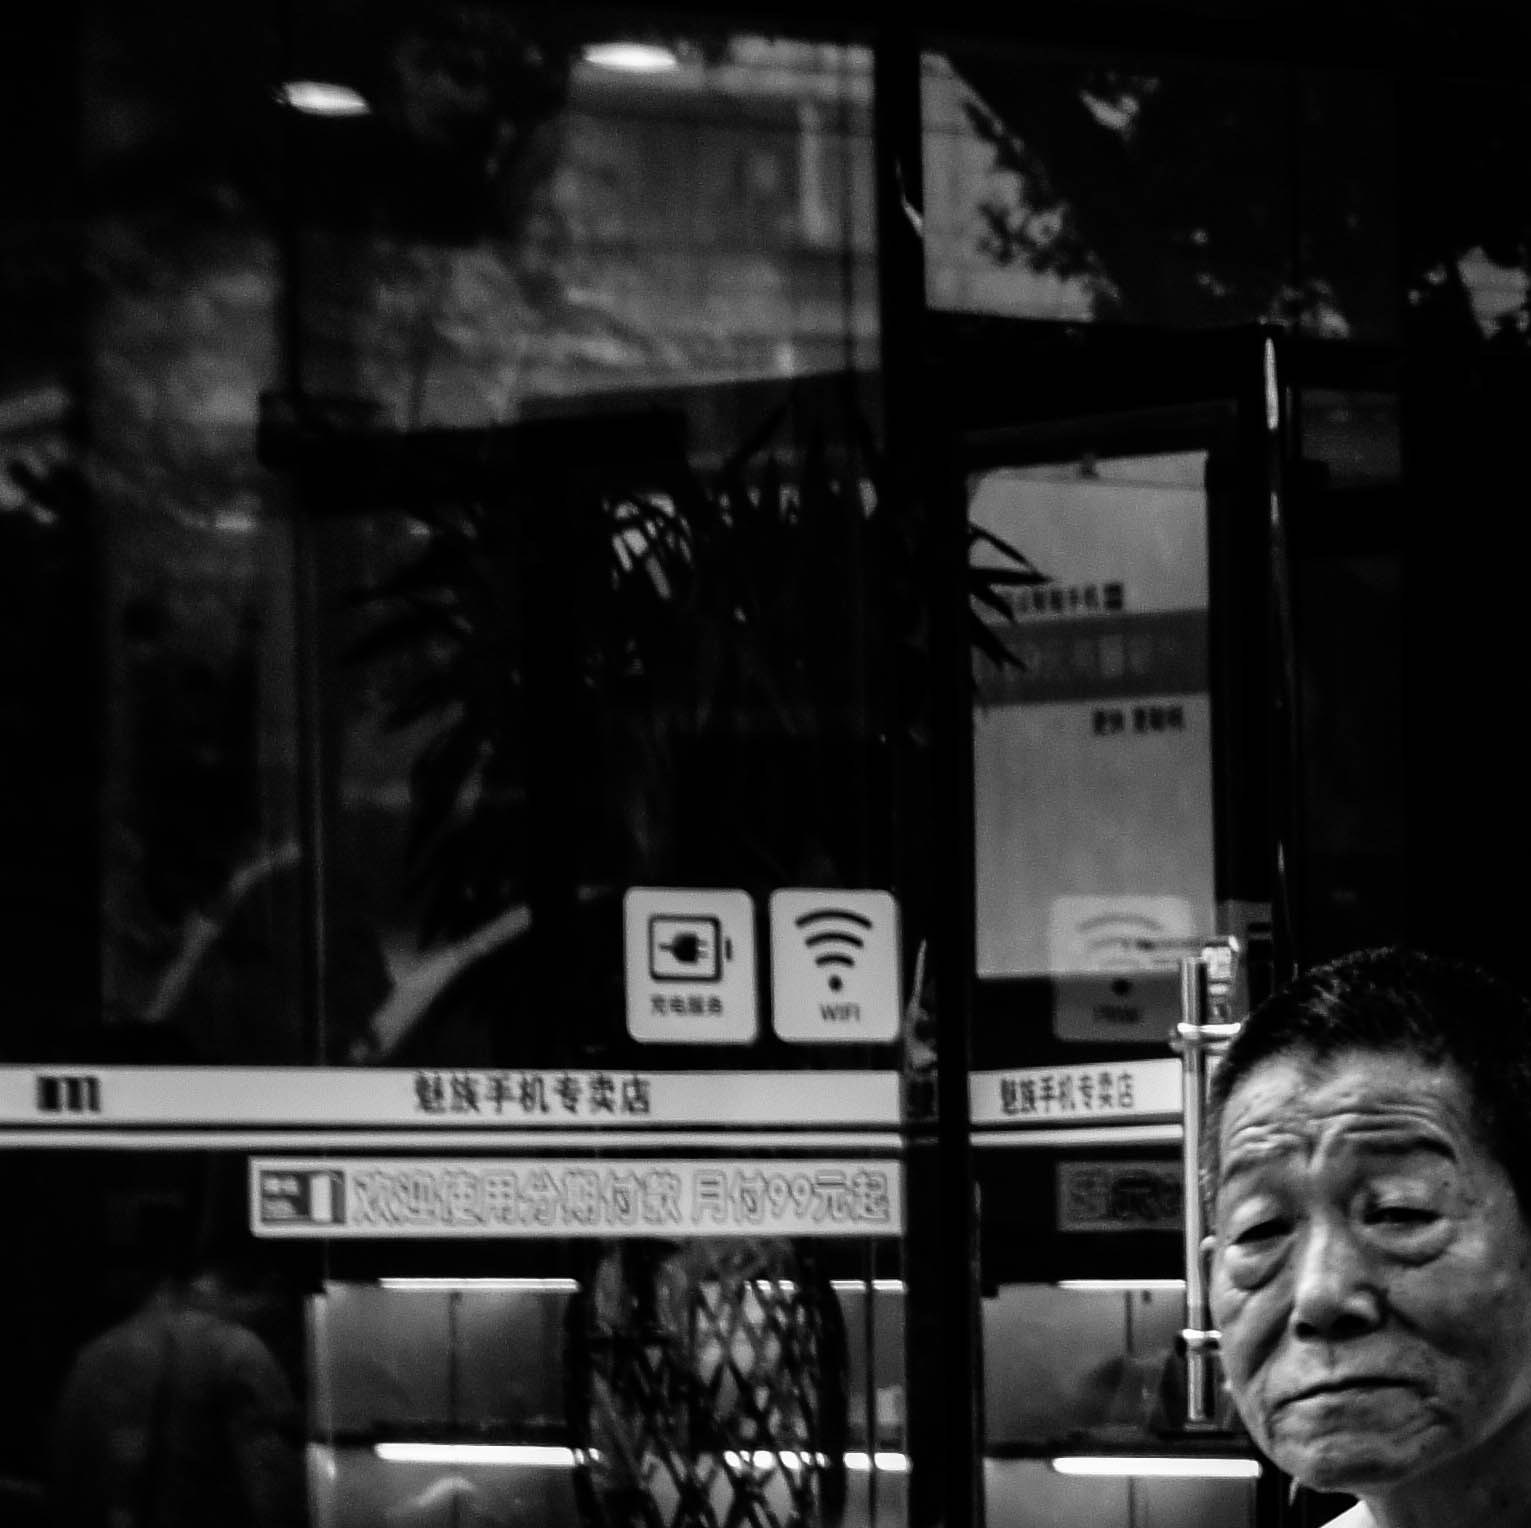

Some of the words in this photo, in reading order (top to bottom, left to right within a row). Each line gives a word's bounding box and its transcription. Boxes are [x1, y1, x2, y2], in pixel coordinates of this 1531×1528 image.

[650, 993, 724, 1017] 充电服务
[819, 1001, 862, 1023] WIFI
[413, 1072, 653, 1117] 魅族手机专卖店
[1000, 1071, 1136, 1115] 魅族手机专卖店
[354, 1168, 682, 1226] 欢迎使用分期付款
[692, 1165, 890, 1226] 月付99元起
